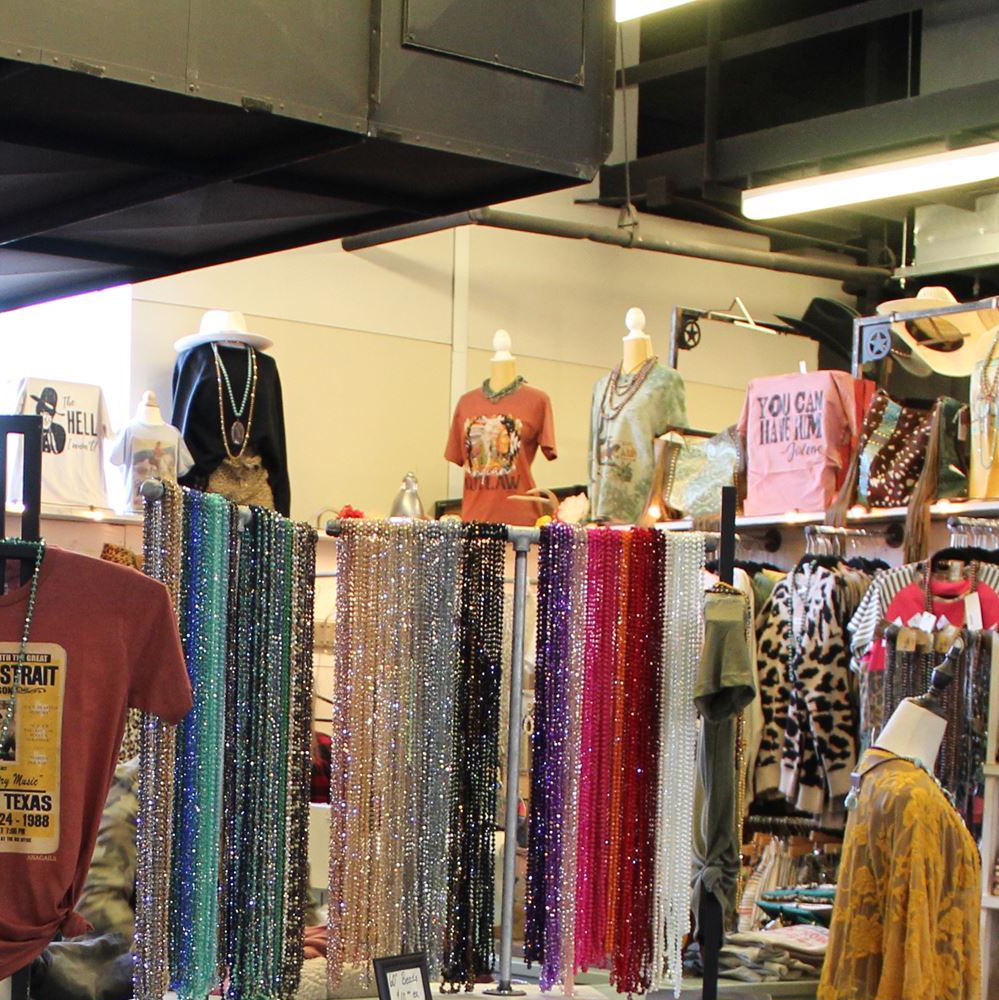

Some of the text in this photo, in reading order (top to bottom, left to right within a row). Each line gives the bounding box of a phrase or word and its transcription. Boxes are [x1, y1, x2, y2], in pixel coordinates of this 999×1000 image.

[757, 390, 824, 419] YOU CAN
[67, 410, 98, 437] HELL
[759, 412, 822, 445] HAVE HIM
[0, 664, 59, 686] STRAIT
[3, 793, 52, 811] TEXAS
[23, 814, 50, 828] 1988
